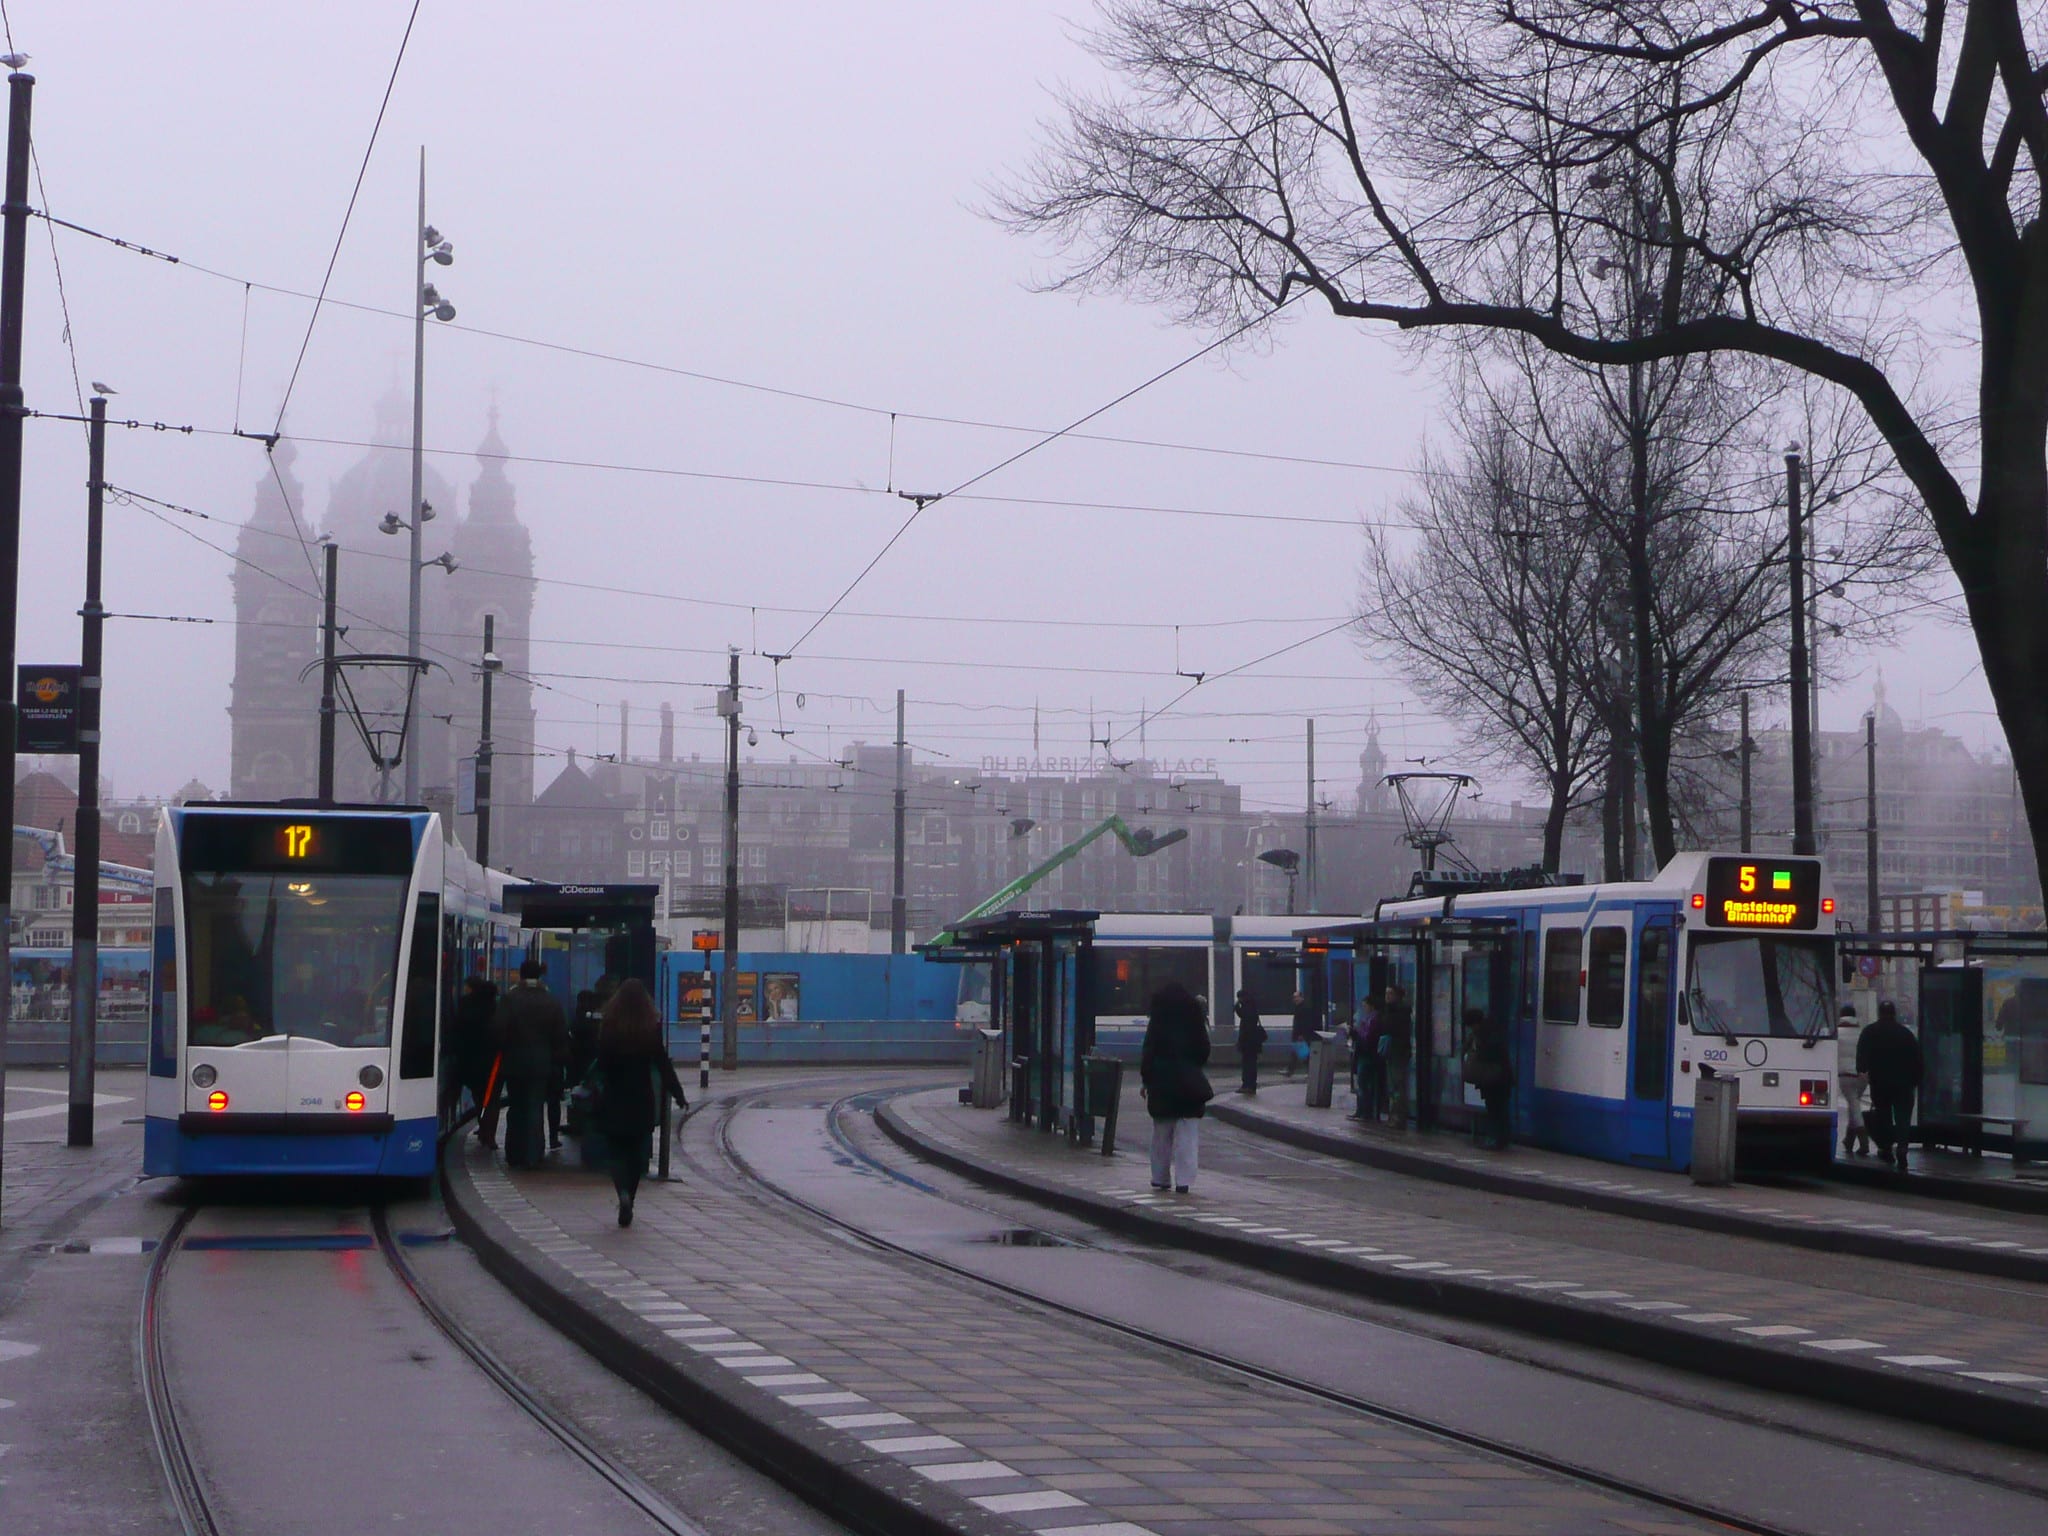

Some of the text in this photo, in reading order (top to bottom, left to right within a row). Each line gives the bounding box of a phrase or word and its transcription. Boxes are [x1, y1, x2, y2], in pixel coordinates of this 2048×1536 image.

[284, 825, 311, 857] 17
[1740, 866, 1755, 892] 5
[559, 885, 605, 894] JCDecaux
[1723, 900, 1797, 914] Amstelveen
[1727, 910, 1793, 924] Binnenhof
[1704, 1049, 1728, 1061] 920
